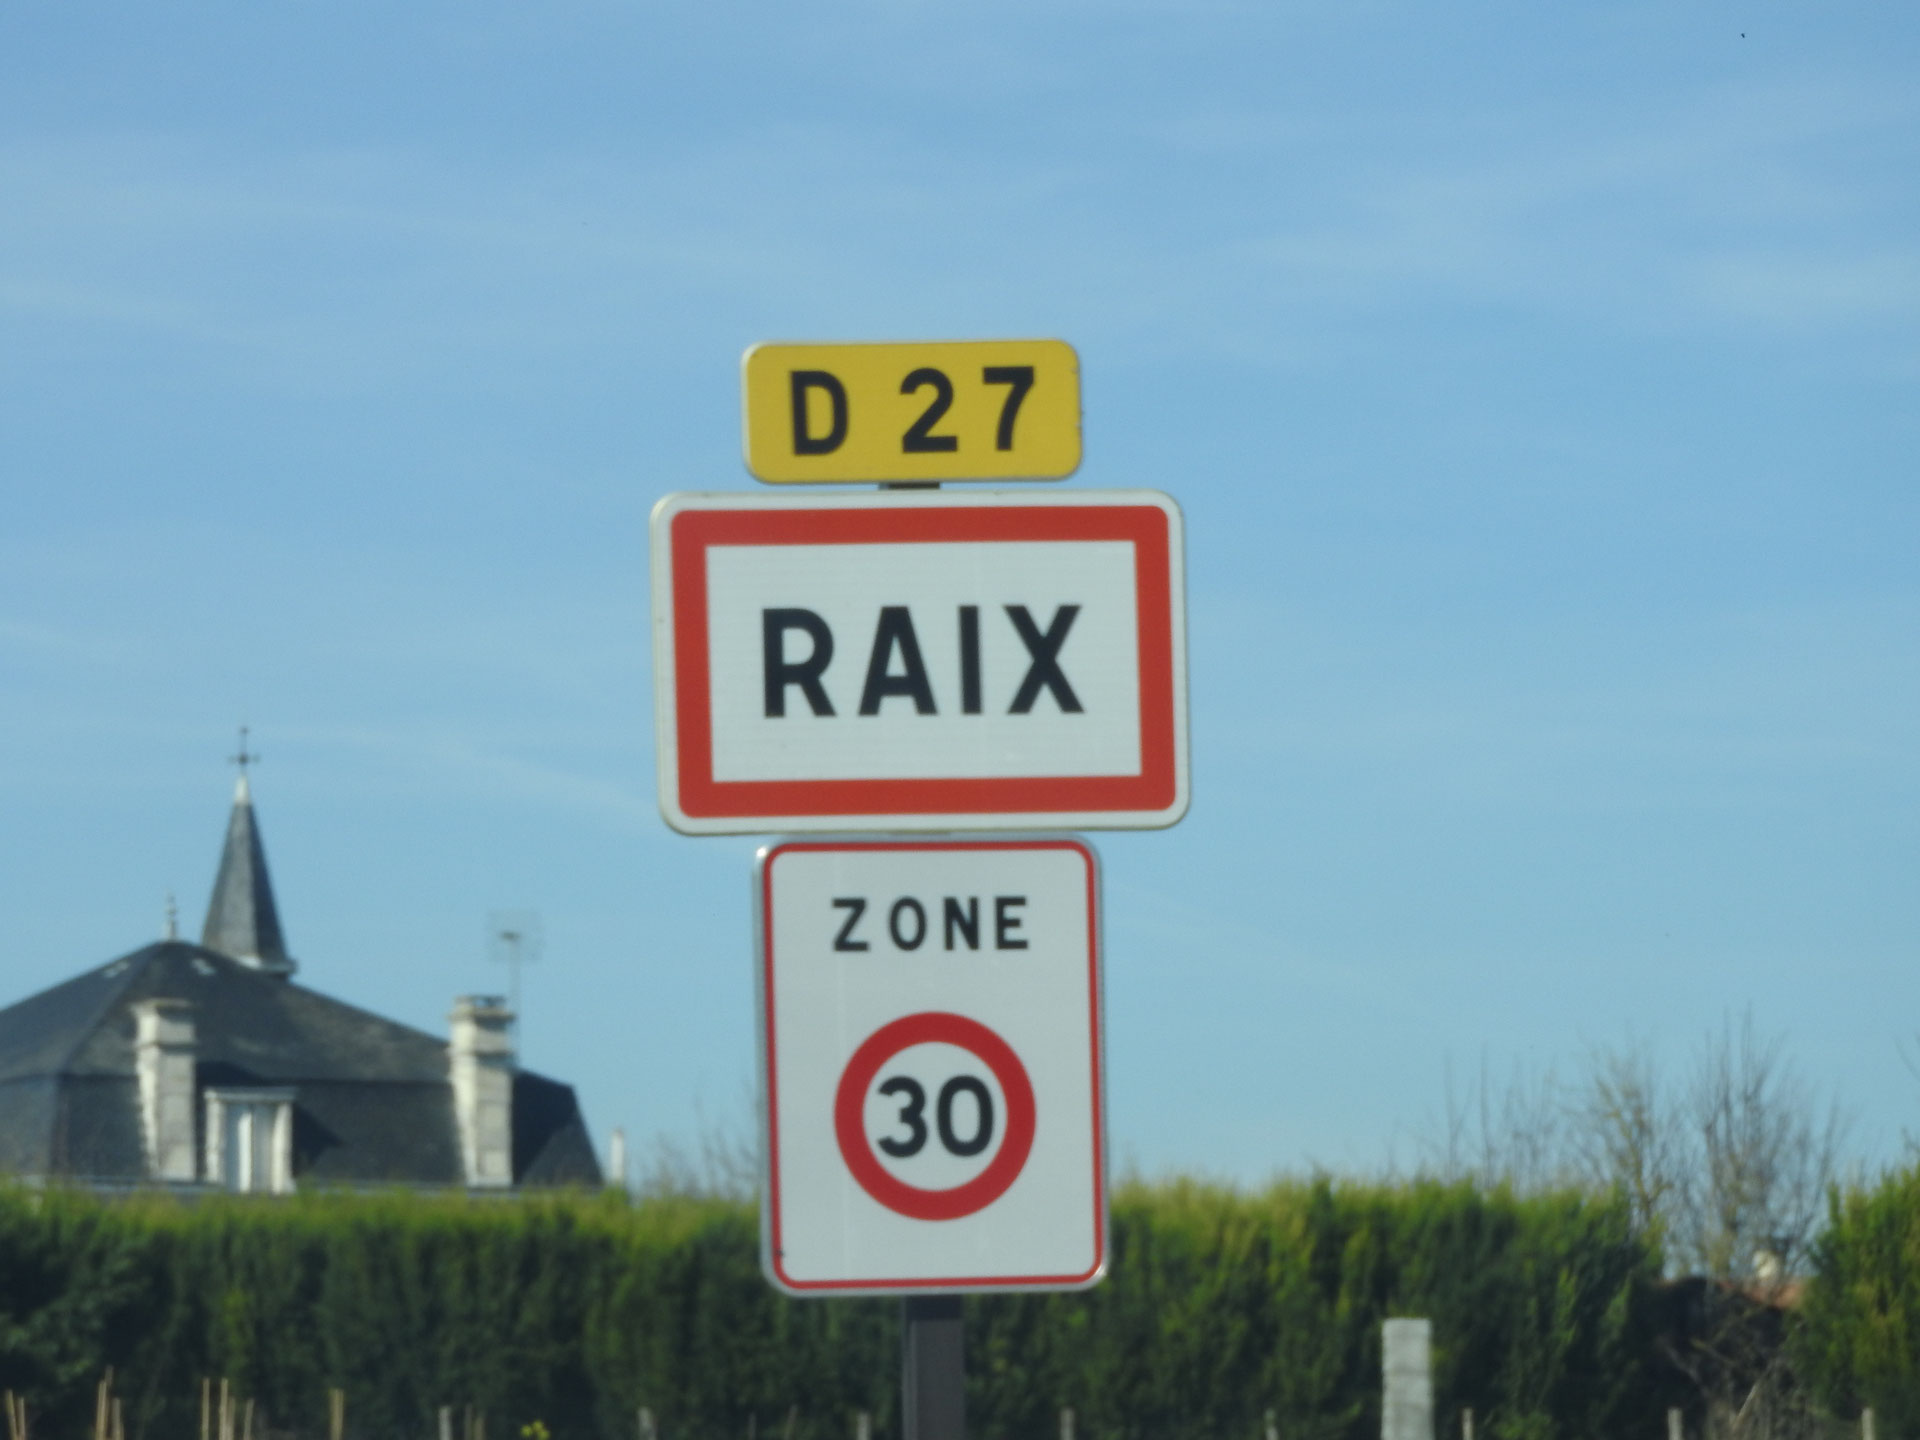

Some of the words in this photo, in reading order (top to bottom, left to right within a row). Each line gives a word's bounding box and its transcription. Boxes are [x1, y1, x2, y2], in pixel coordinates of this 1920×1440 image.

[789, 369, 849, 456] D
[899, 365, 1036, 454] 27
[761, 604, 1084, 718] RAIX
[832, 895, 1029, 952] ZONE
[876, 1075, 994, 1159] 30
